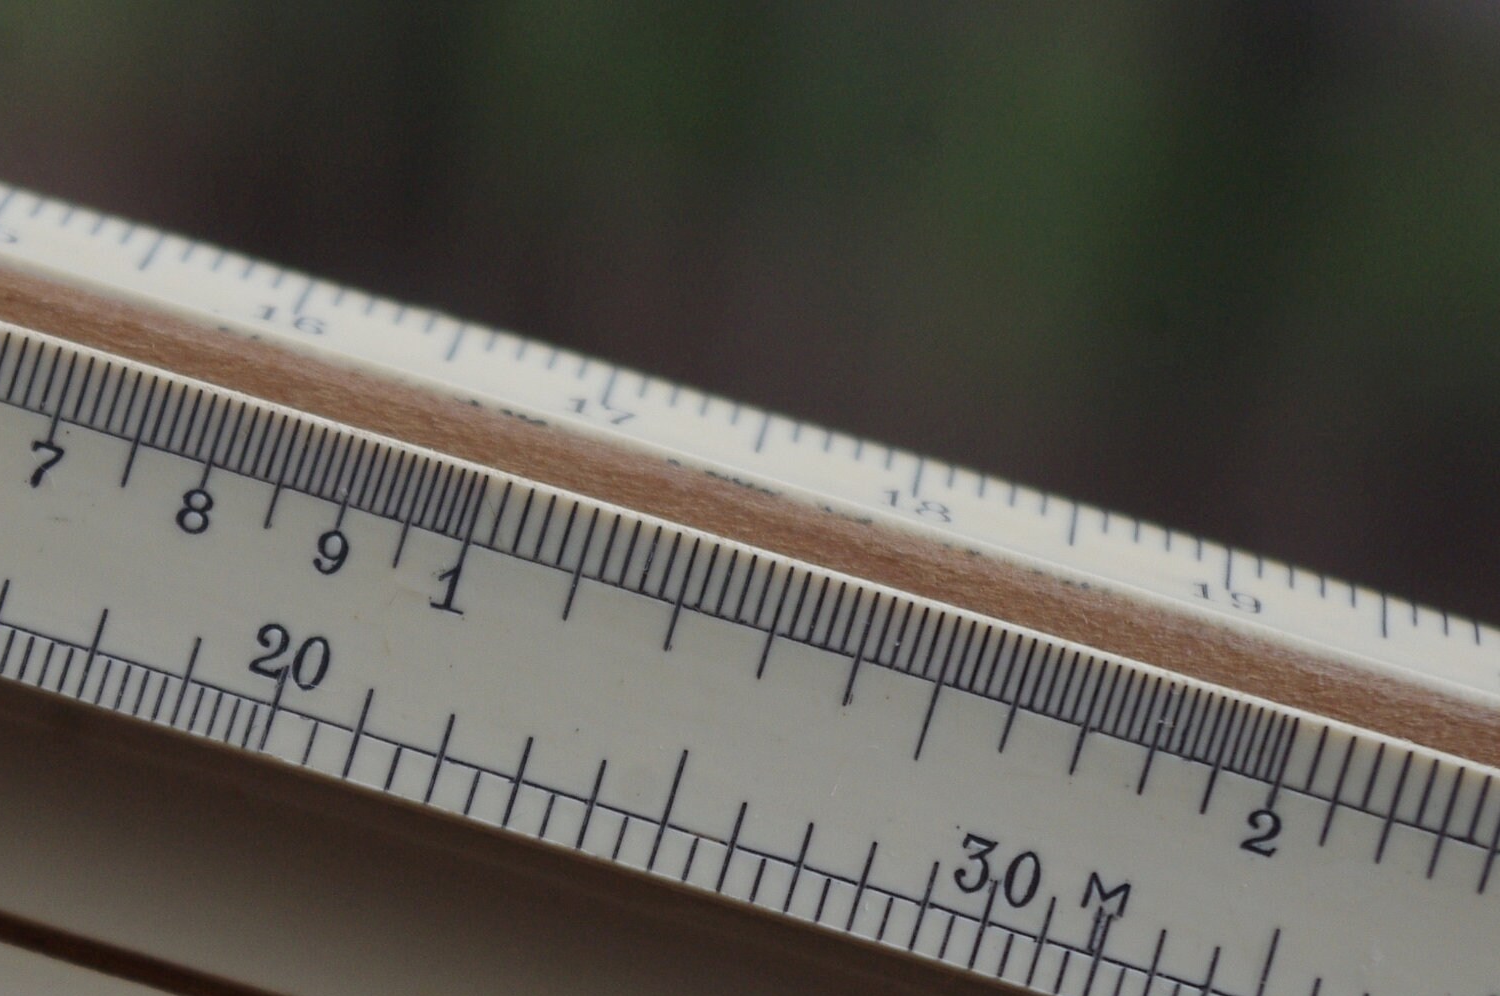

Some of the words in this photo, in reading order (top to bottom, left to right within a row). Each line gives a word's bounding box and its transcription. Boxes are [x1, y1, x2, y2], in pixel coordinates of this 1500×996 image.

[30, 440, 65, 488] 7
[175, 488, 215, 535] 8
[313, 530, 350, 575] 9
[430, 564, 464, 616] 1
[1241, 807, 1284, 857] 2
[881, 490, 951, 523] 18
[1192, 582, 1262, 614] 19
[248, 623, 331, 691] 20
[953, 832, 1041, 909] 30
